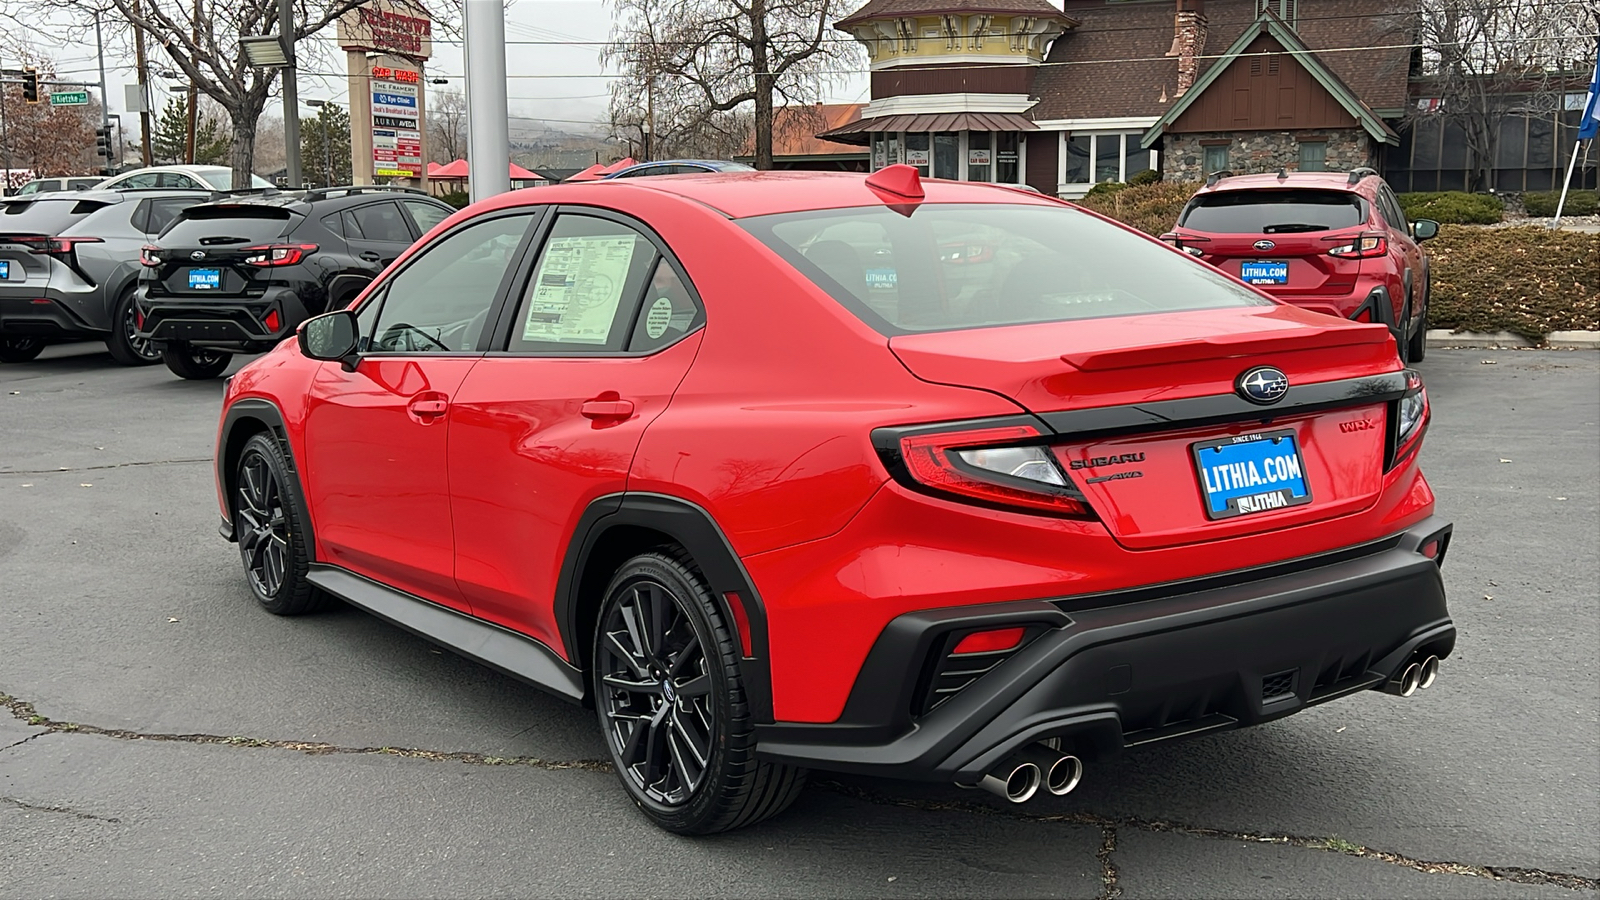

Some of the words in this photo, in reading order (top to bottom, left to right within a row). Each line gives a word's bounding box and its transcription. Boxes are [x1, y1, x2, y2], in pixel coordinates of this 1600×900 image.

[372, 66, 391, 78] CAR
[394, 69, 419, 82] WASH
[388, 84, 415, 92] FRAMERY
[56, 94, 79, 103] Kietzke
[387, 95, 397, 104] Eye
[397, 96, 411, 104] Clinic
[375, 118, 396, 126] AURA
[398, 120, 416, 128] AVEDA
[1241, 267, 1287, 277] LITHIA.COM
[189, 274, 219, 283] LITHIA.COM
[865, 273, 897, 282] LITHIA.CO
[1339, 418, 1376, 434] WRX
[1232, 435, 1249, 443] SINCE
[1249, 433, 1262, 441] 1946
[1069, 452, 1146, 470] SUBARU
[1108, 471, 1144, 481] AWD
[1202, 453, 1302, 494] LITHIA.COM
[1249, 491, 1288, 511] LITHIA
